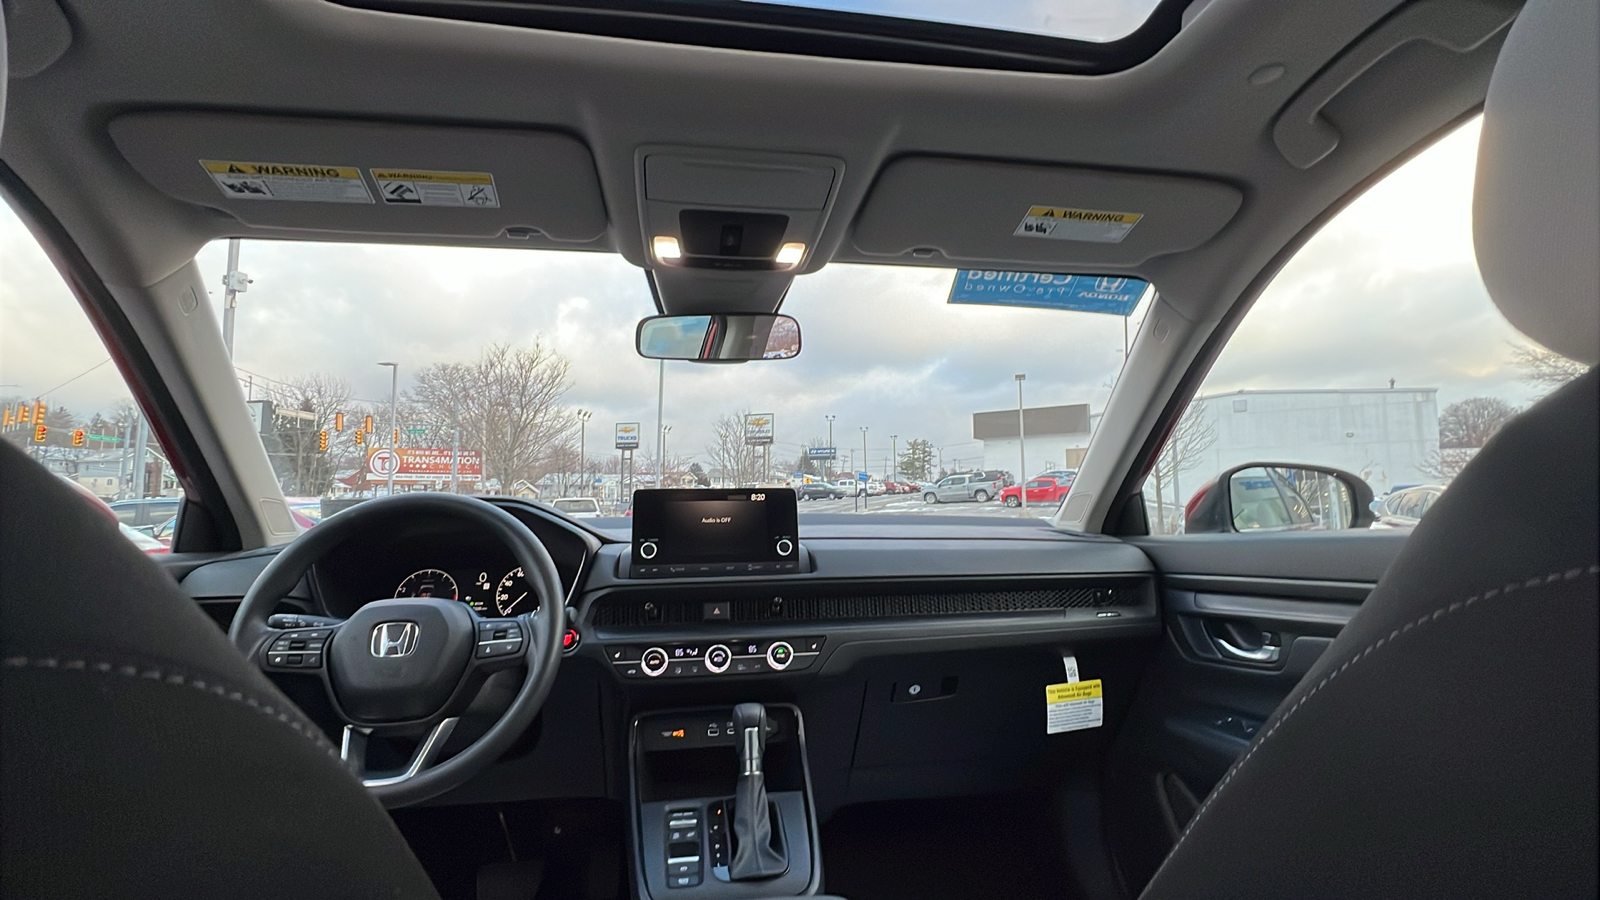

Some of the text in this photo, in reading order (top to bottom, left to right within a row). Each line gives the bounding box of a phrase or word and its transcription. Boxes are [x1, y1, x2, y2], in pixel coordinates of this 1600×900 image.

[252, 165, 340, 178] WARNING
[1062, 210, 1124, 222] WARNING
[402, 455, 480, 465] TRANS4MATION
[750, 493, 766, 501] 8:20
[500, 593, 509, 601] 20
